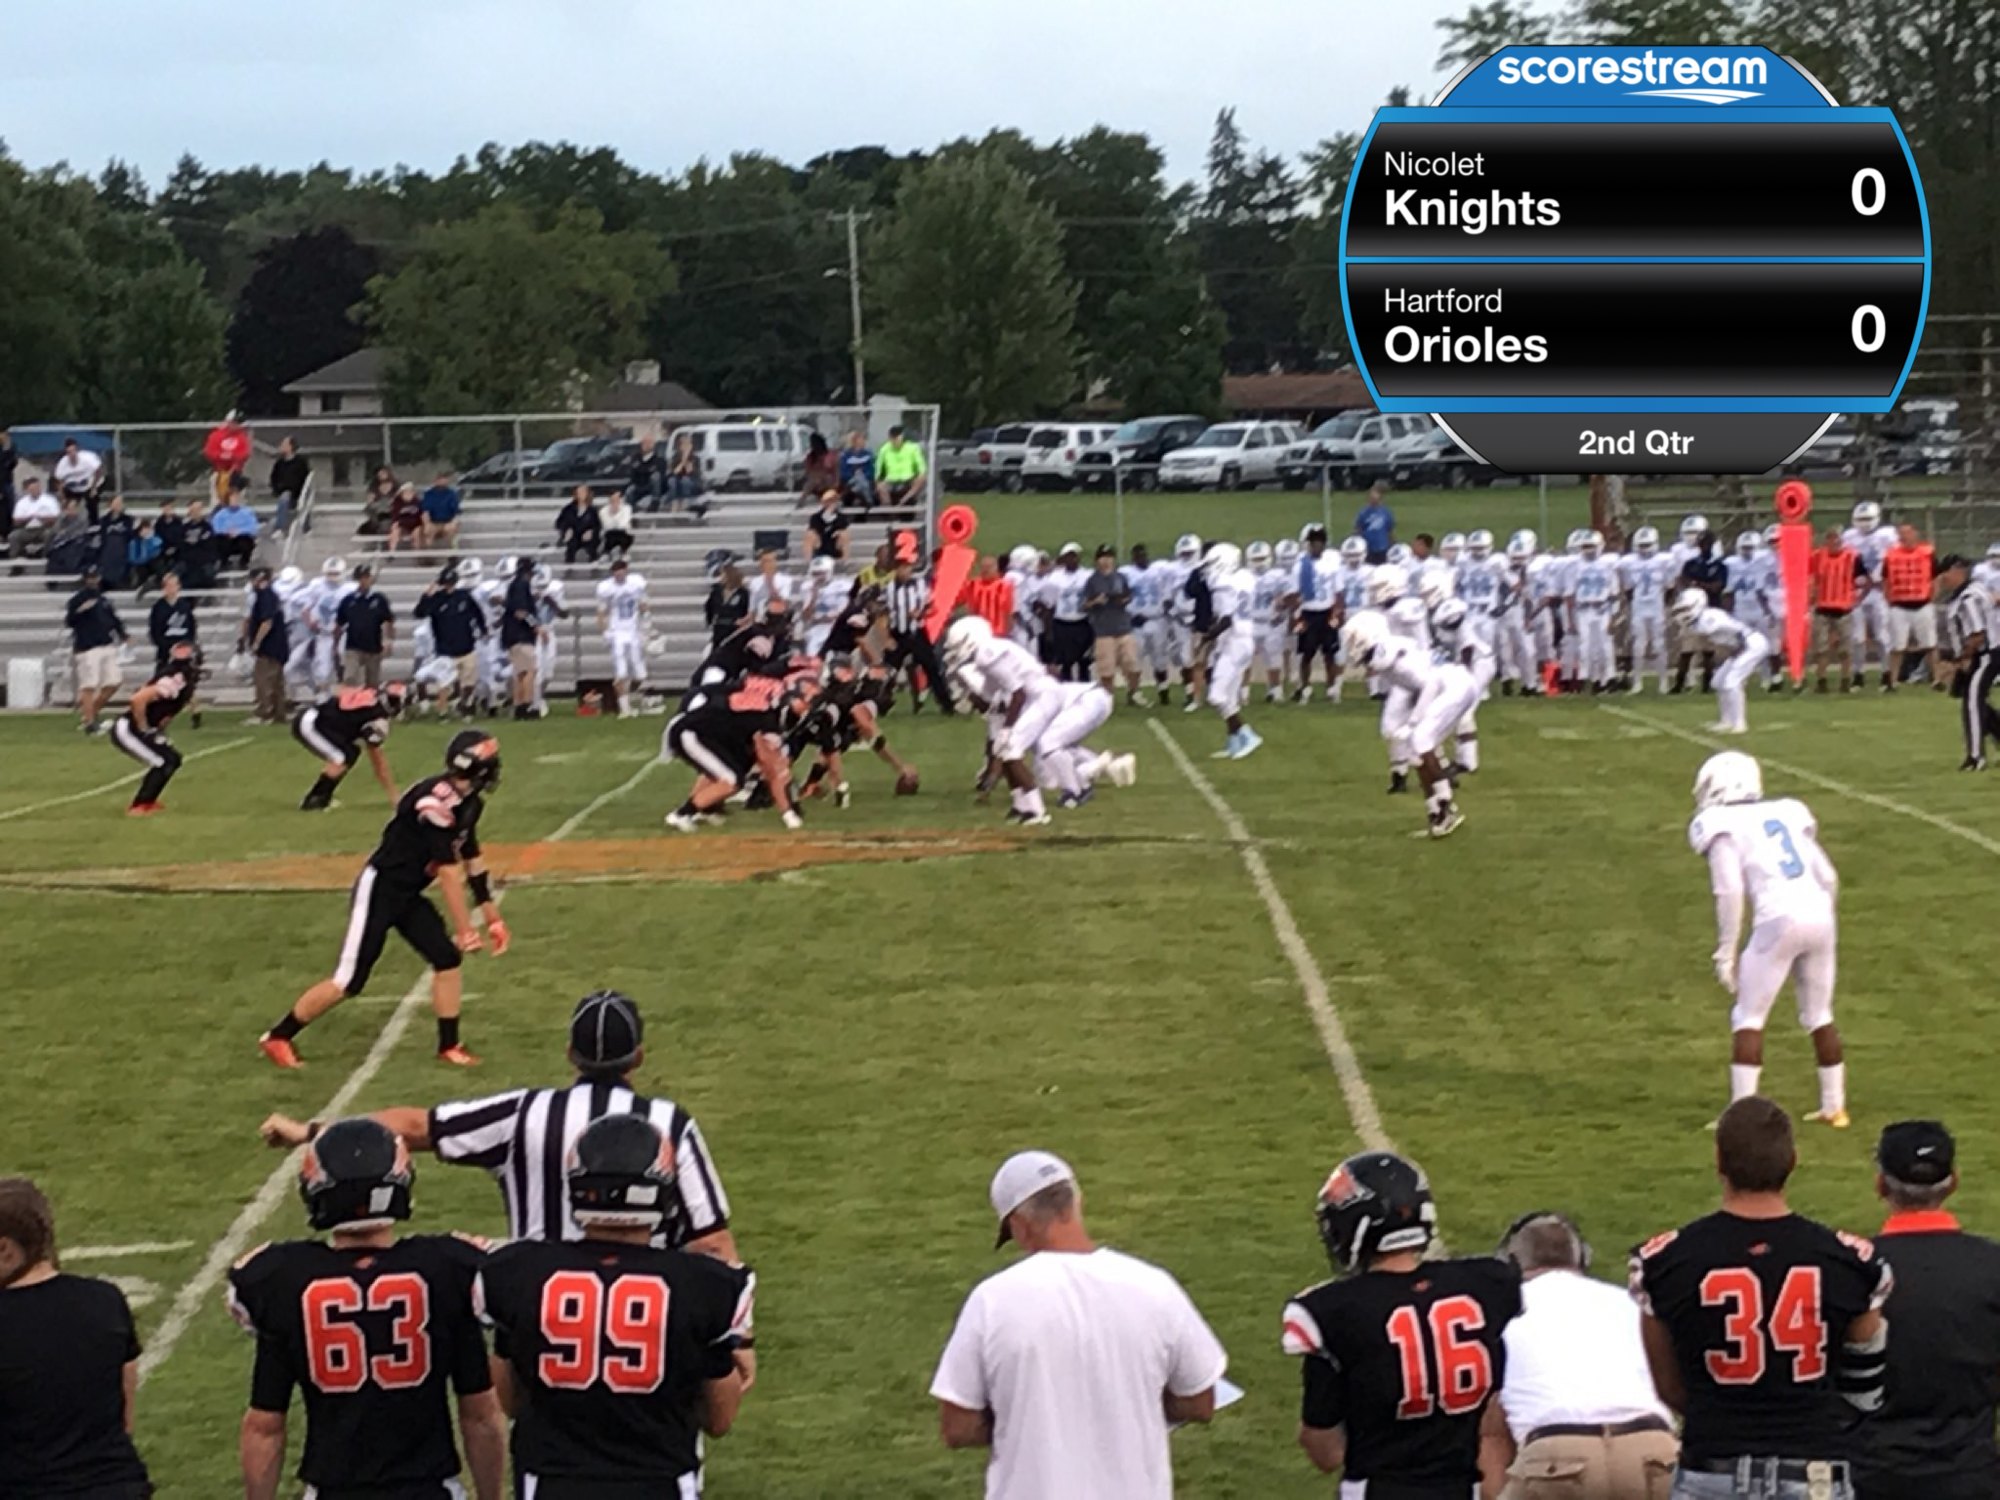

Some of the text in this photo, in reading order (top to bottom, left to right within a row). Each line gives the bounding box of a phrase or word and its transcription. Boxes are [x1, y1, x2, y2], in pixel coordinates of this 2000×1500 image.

[894, 530, 919, 564] 2
[1764, 818, 1805, 880] 3
[301, 1272, 431, 1394] 63
[538, 1270, 671, 1394] 99
[1386, 1295, 1493, 1419] 16
[1700, 1267, 1827, 1385] 34
